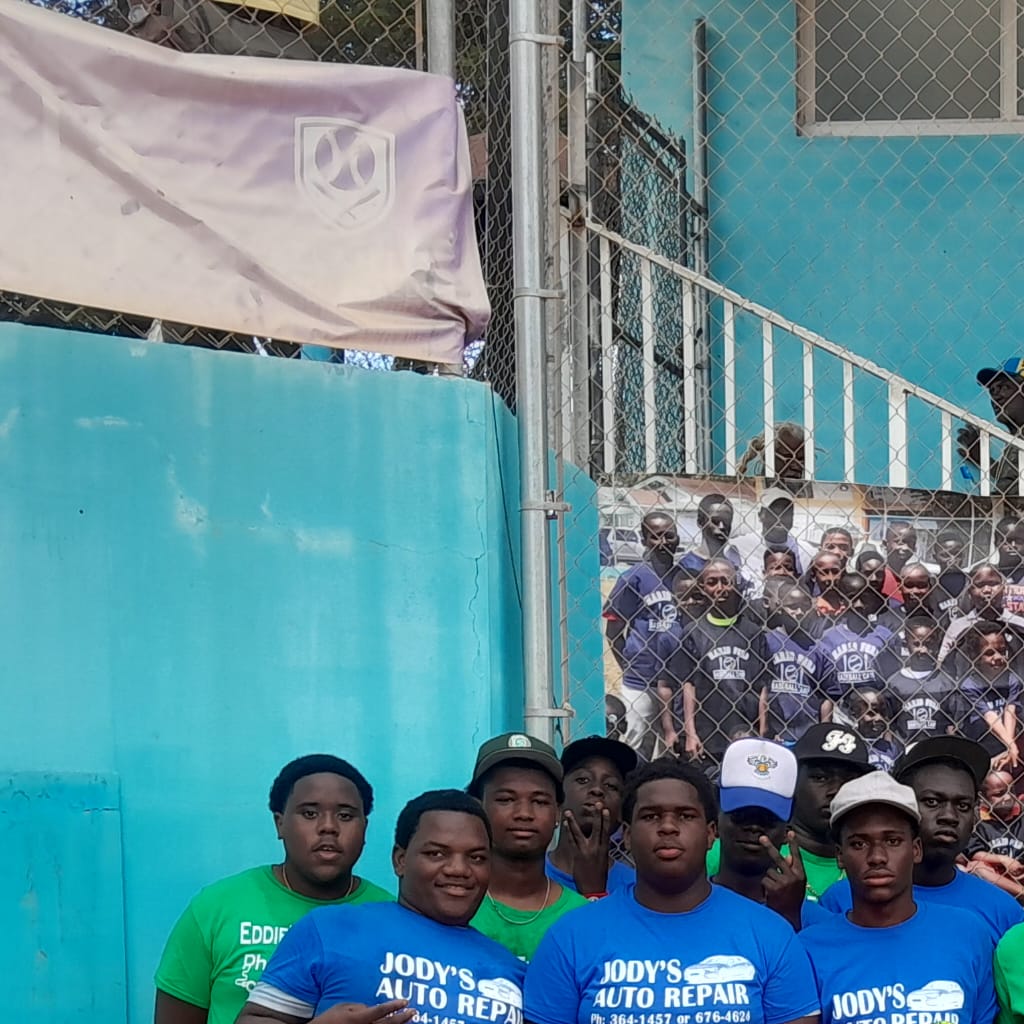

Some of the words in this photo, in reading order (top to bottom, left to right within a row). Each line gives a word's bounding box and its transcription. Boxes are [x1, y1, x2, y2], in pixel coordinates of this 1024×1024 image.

[240, 921, 293, 945] EDDIE
[379, 951, 476, 991] JODY'S
[600, 958, 683, 985] JODY'S
[375, 977, 448, 1010] AUTO
[592, 985, 655, 1009] AUTO
[663, 984, 750, 1009] REPAIR
[832, 982, 906, 1021] JODY'S
